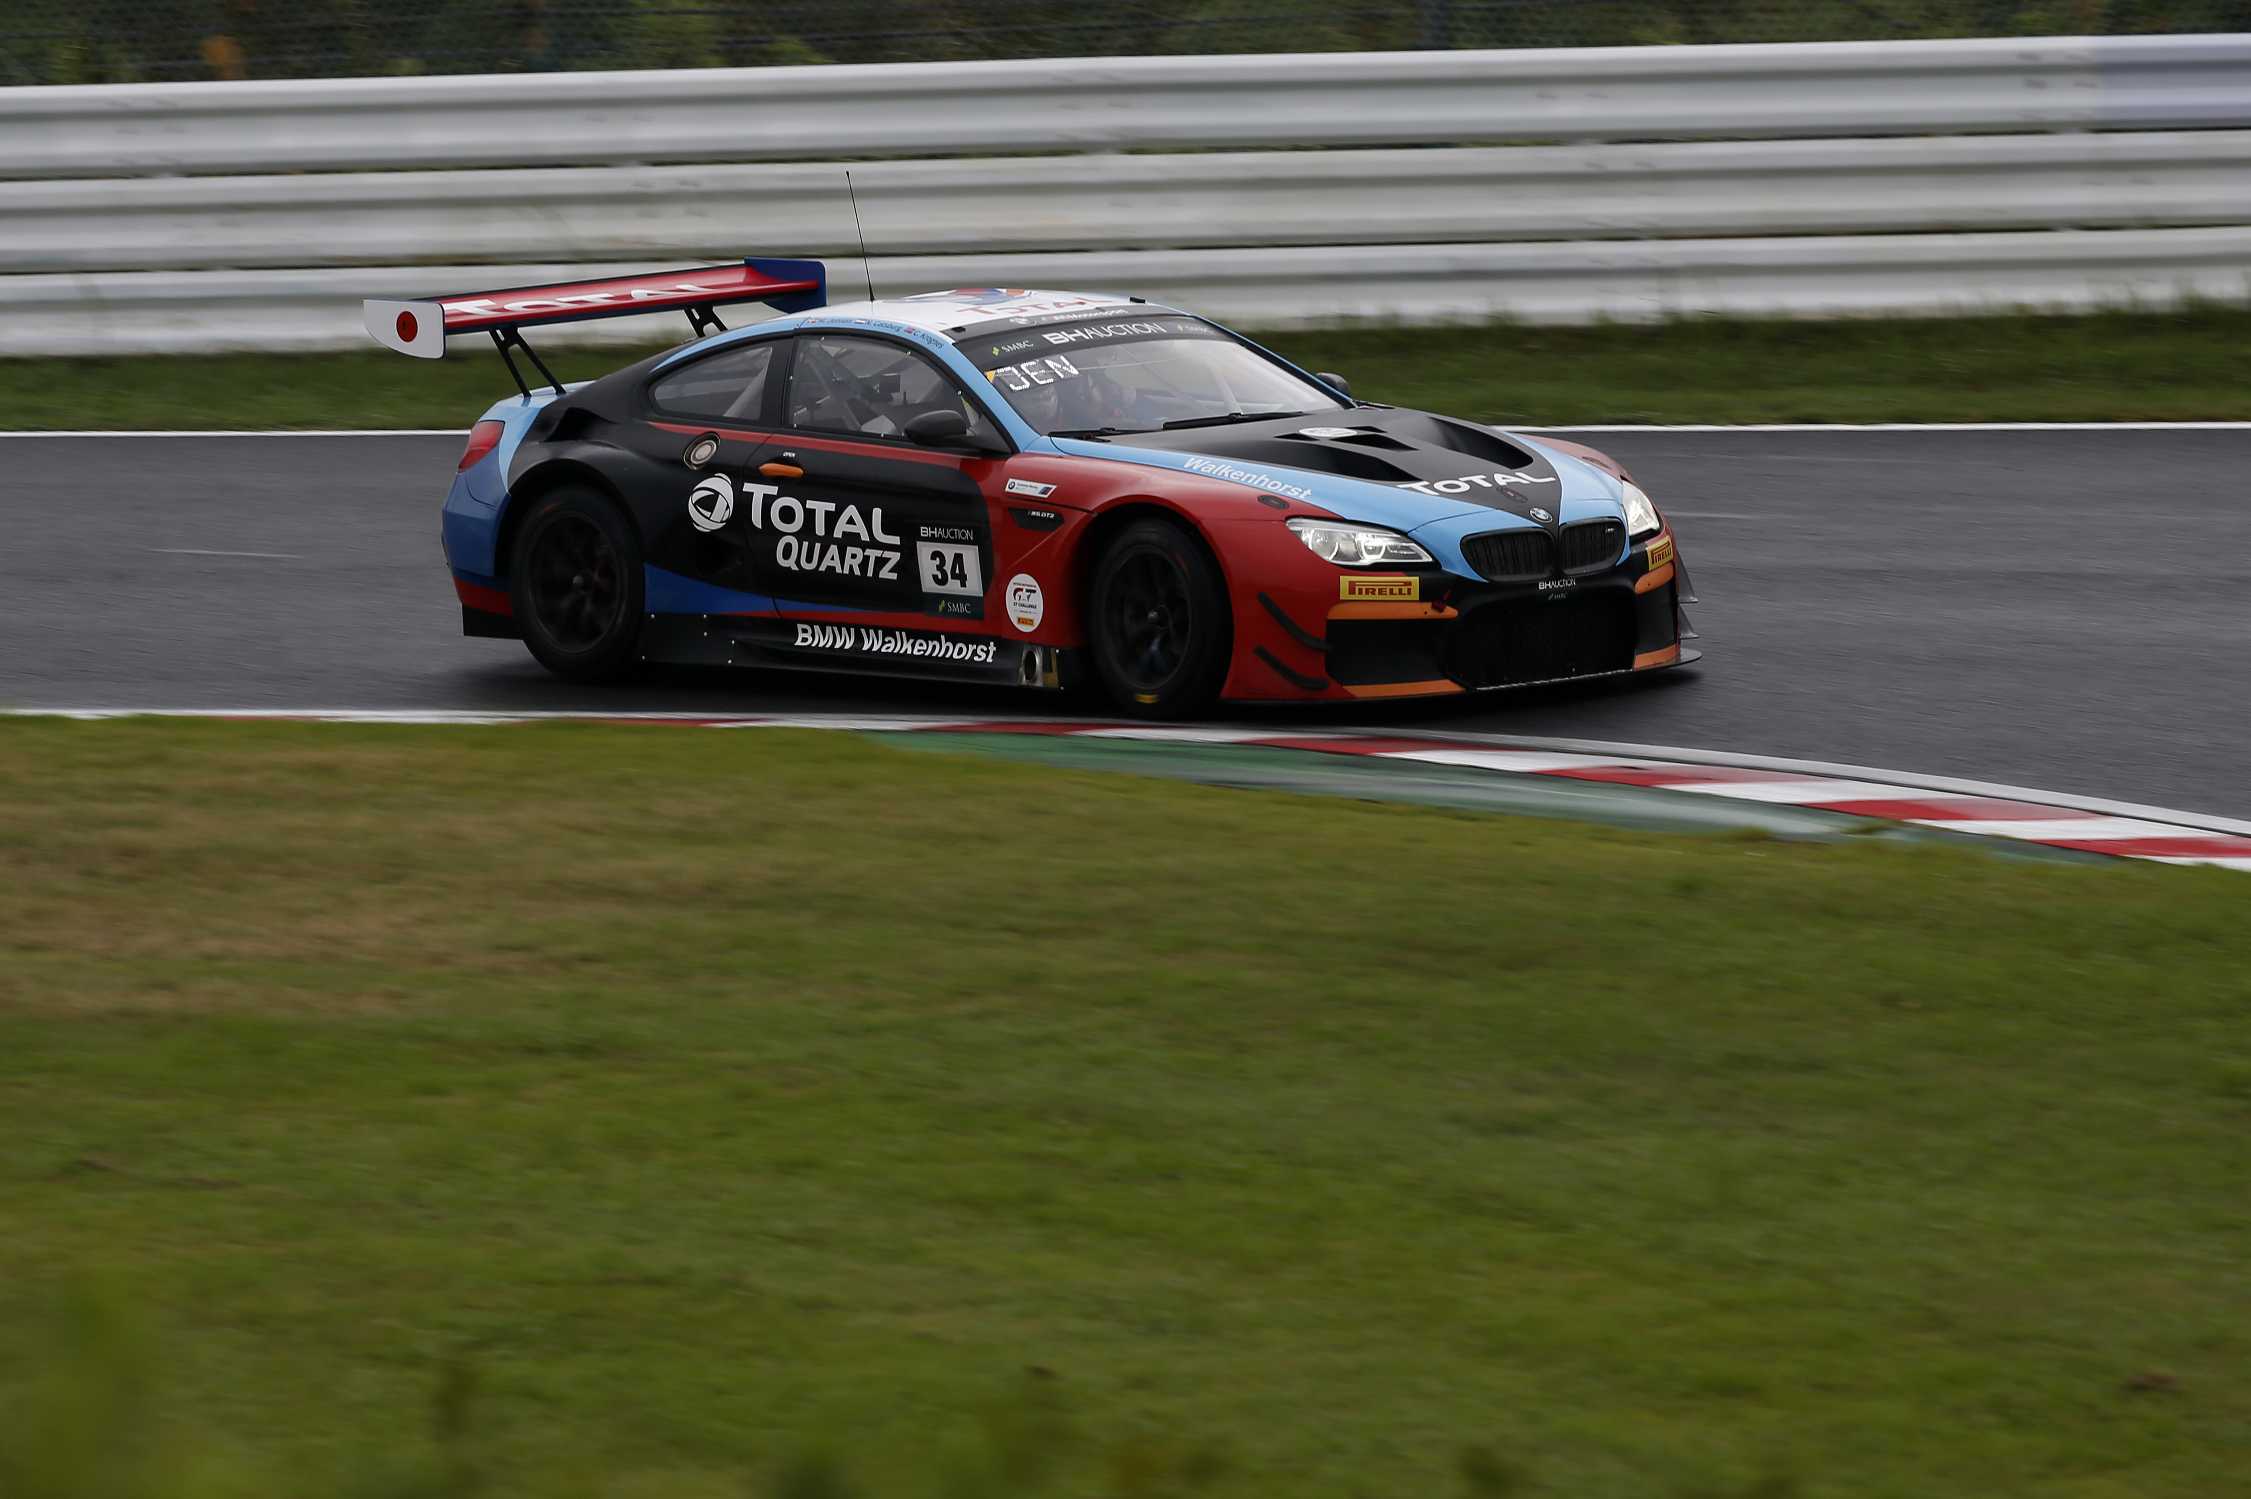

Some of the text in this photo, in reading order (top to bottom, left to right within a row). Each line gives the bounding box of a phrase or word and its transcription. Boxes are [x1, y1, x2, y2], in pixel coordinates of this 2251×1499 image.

[444, 284, 716, 316] TOTAL
[997, 356, 1080, 391] JEN
[1183, 457, 1313, 499] Walkenhorst
[1396, 472, 1556, 496] TOTAL
[742, 482, 901, 545] TOTAL
[776, 535, 901, 580] QUARTZ
[930, 550, 967, 588] 34
[1650, 541, 1672, 565] PIRELLI
[1348, 580, 1413, 596] PIRELLI
[947, 601, 971, 613] SMBC
[794, 623, 997, 663] BMW Walkenhorst
